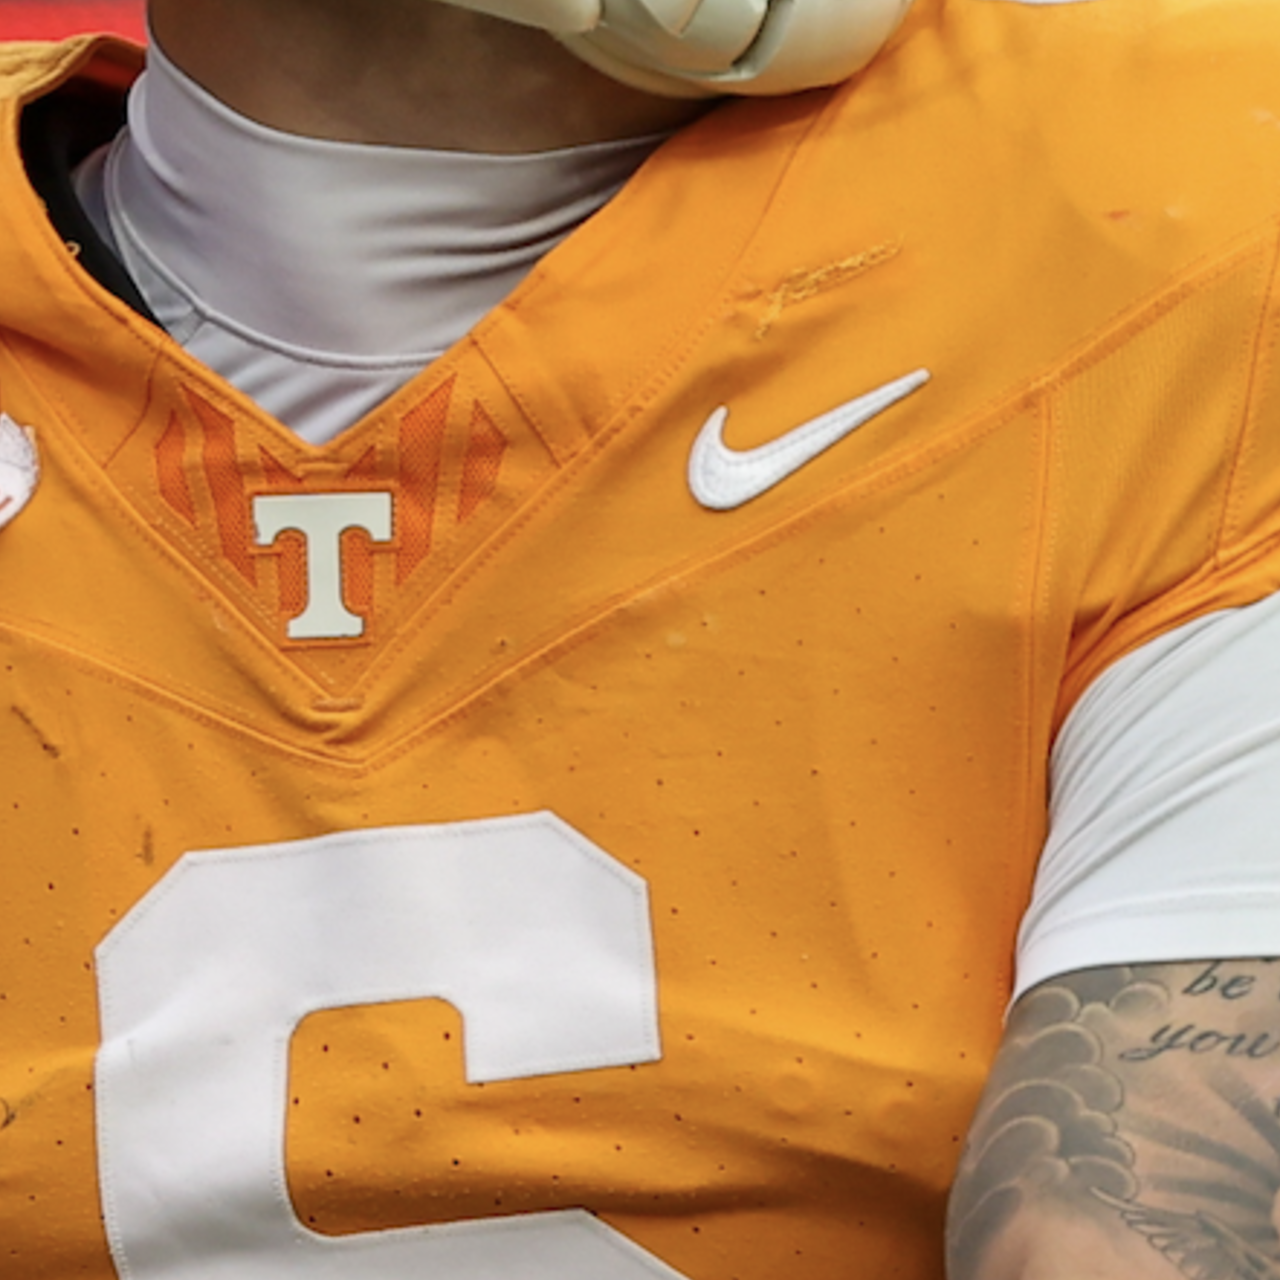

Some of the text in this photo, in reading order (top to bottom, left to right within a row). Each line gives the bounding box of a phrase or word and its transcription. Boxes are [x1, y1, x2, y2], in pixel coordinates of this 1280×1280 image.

[252, 491, 394, 639] T
[1182, 959, 1256, 1000] be
[1118, 1023, 1280, 1063] you
